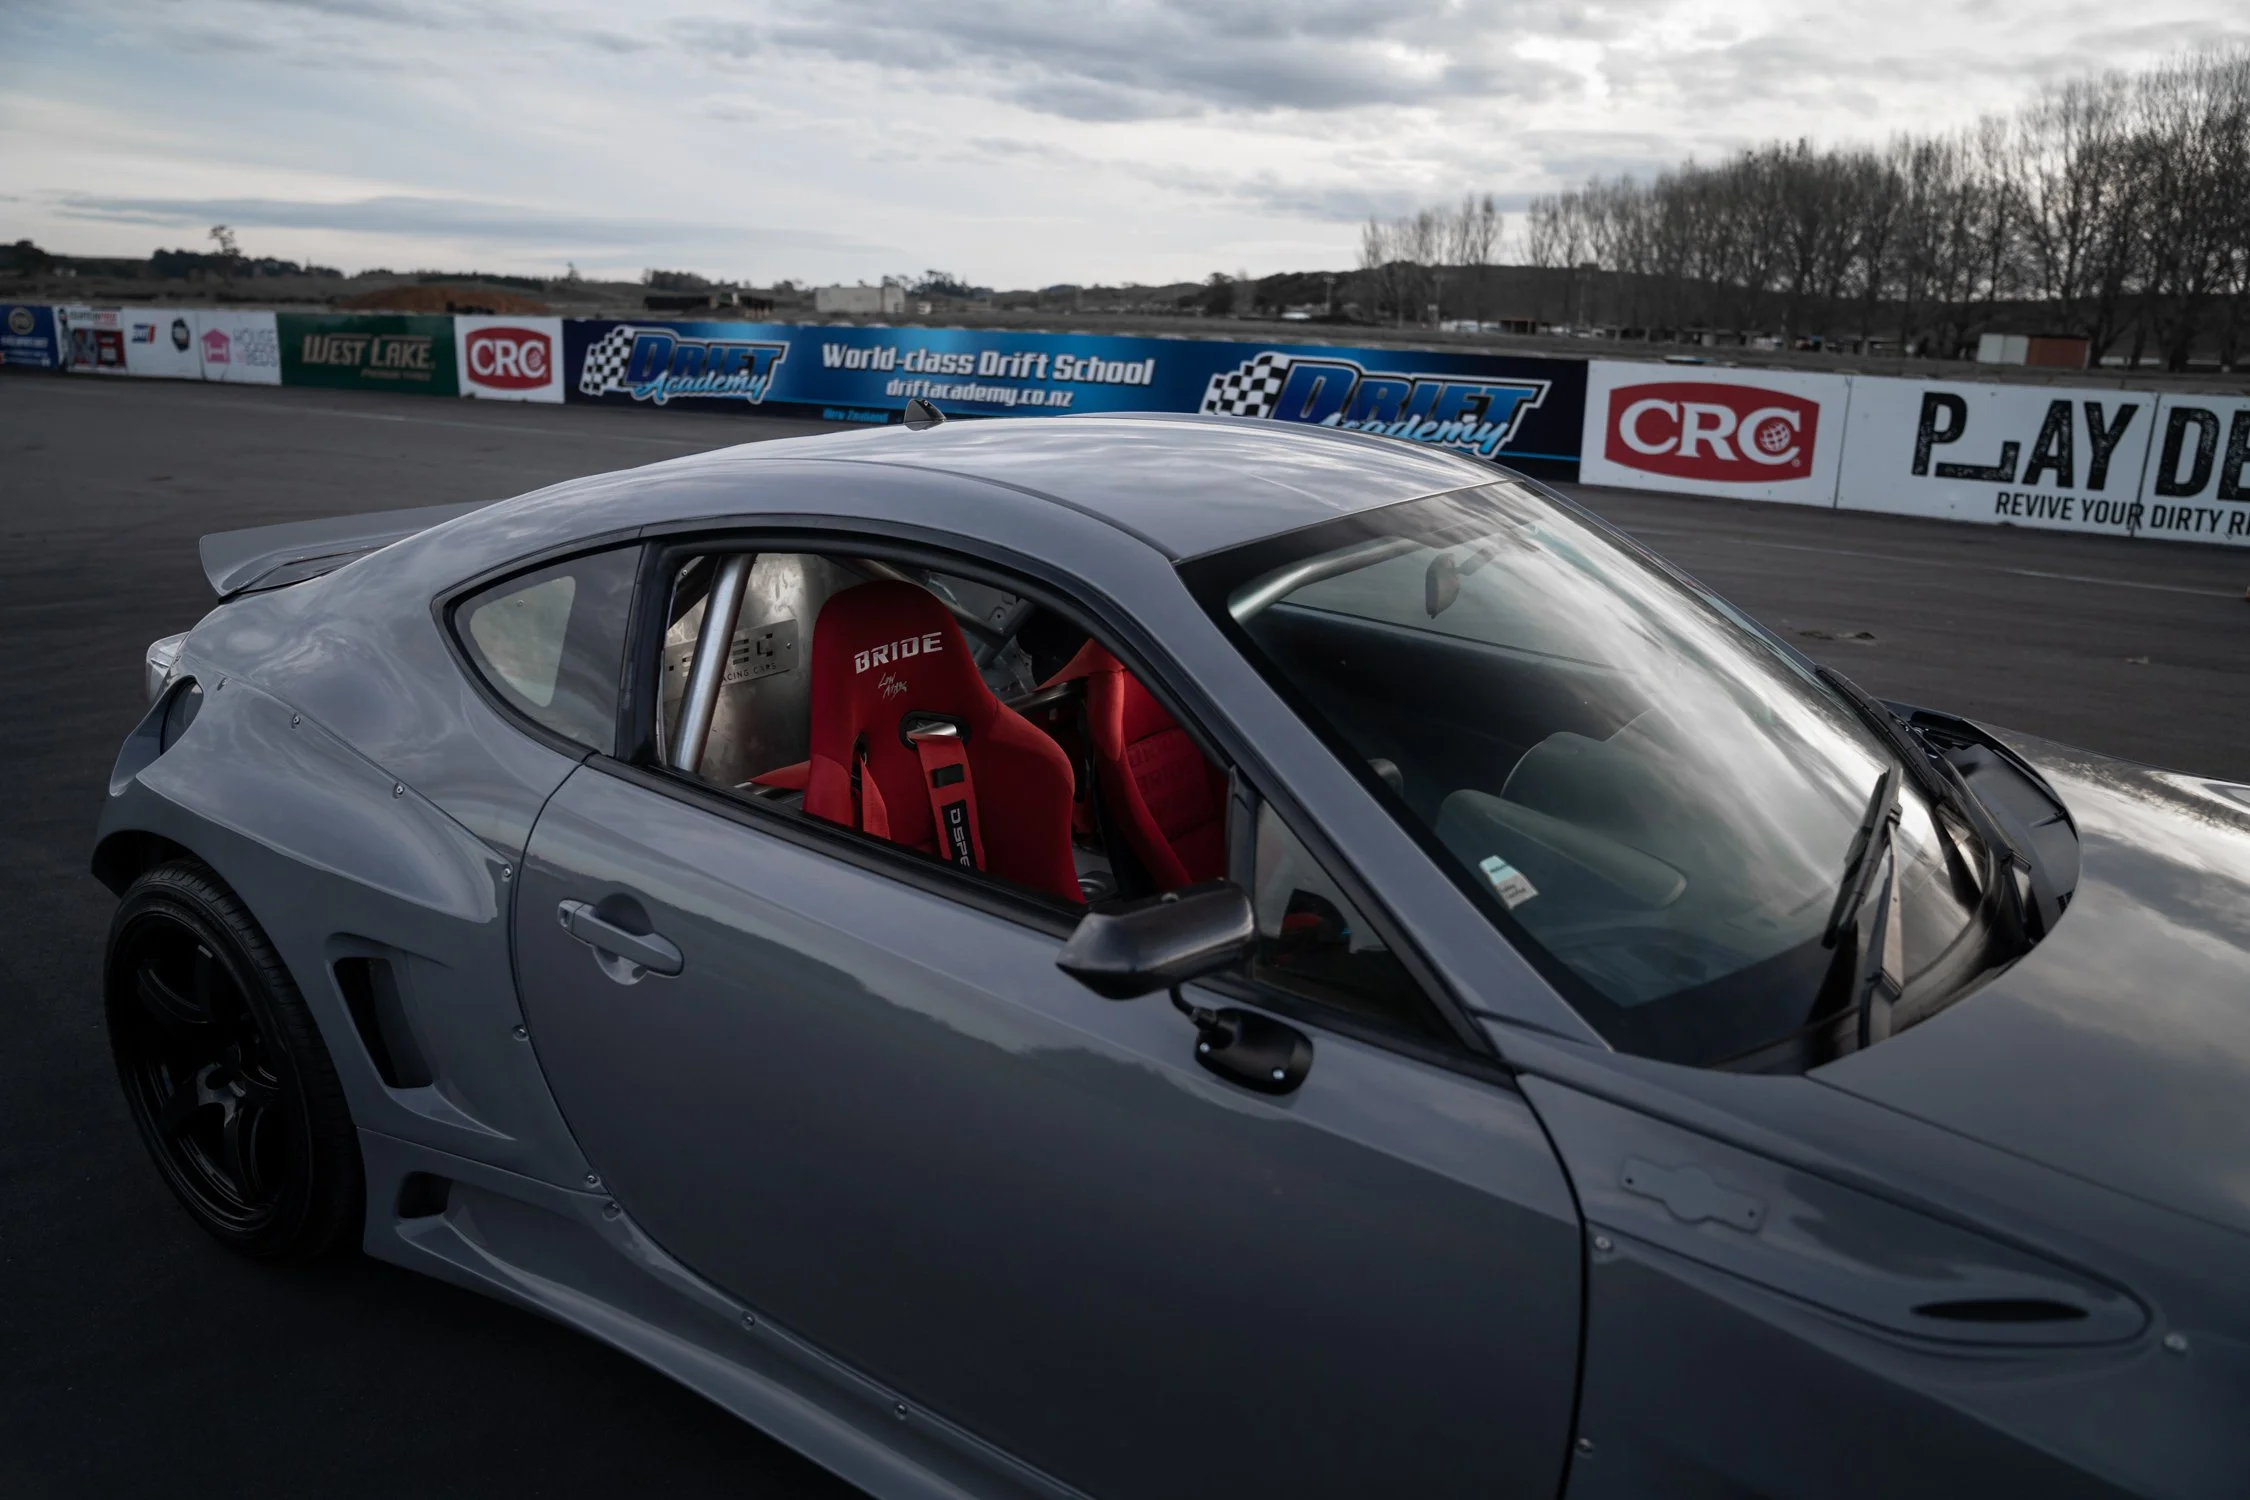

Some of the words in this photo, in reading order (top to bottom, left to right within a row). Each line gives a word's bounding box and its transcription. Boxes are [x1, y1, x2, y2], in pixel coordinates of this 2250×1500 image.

[302, 334, 369, 366] WEST
[370, 335, 433, 370] LAKE
[470, 337, 546, 378] CRC
[625, 332, 783, 384] DRIFT
[822, 343, 974, 376] World-class
[978, 350, 1049, 380] Drift
[1053, 353, 1156, 386] School
[634, 370, 770, 402] Academy
[885, 378, 1074, 408] driftacademy.co.nz
[1272, 361, 1541, 424] DRIFT
[1318, 412, 1511, 454] ademy
[1619, 398, 1801, 466] CRC
[1995, 491, 2076, 521] REVIVE
[2080, 499, 2145, 531] YOUR
[2150, 504, 2224, 534] DIRTY
[853, 631, 944, 674] BRIDE
[723, 669, 750, 682] ACING
